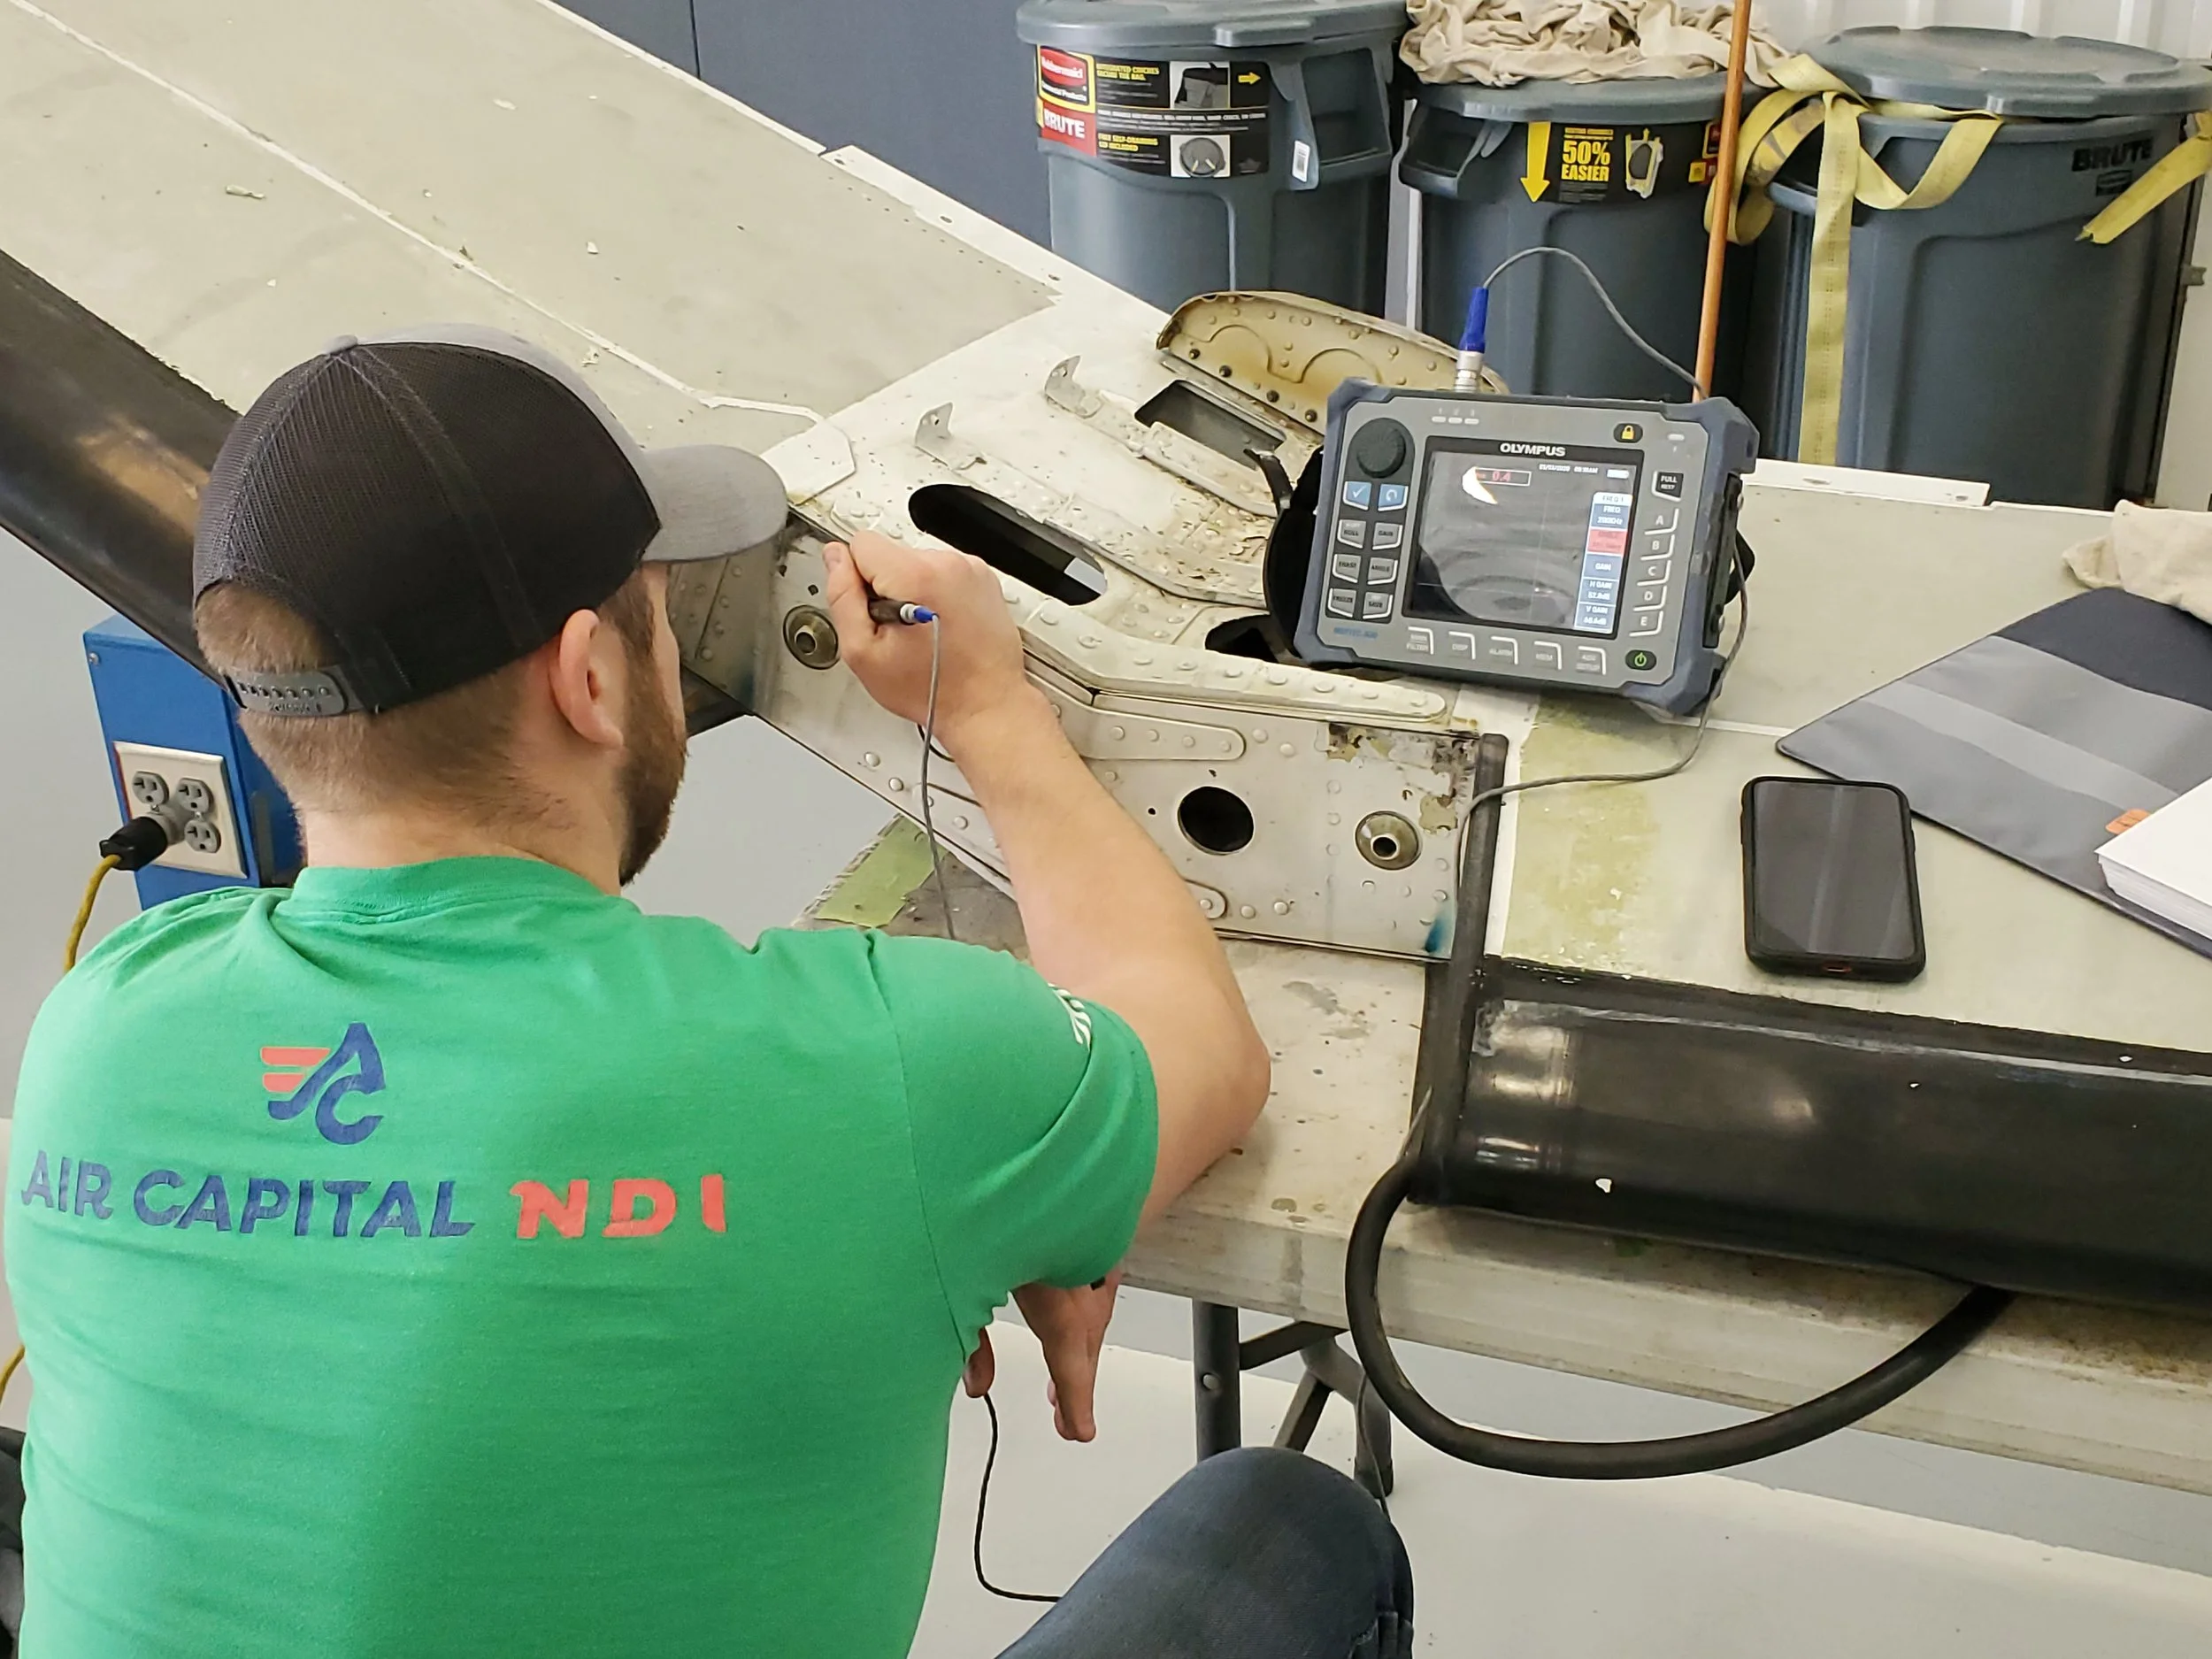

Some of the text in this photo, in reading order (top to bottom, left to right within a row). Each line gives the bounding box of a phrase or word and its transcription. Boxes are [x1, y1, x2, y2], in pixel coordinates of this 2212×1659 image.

[1563, 140, 1610, 165] 50%
[2072, 137, 2154, 172] BRUTE
[1561, 164, 1609, 182] EASIER
[1500, 442, 1566, 457] OLYMPUS
[1661, 475, 1678, 484] FULL
[1655, 514, 1664, 526] A
[1651, 540, 1660, 550] B
[1647, 565, 1657, 577] C
[1644, 590, 1654, 601] D
[1640, 616, 1648, 626] E
[21, 1150, 727, 1239] AIR CAPITAL NDI
